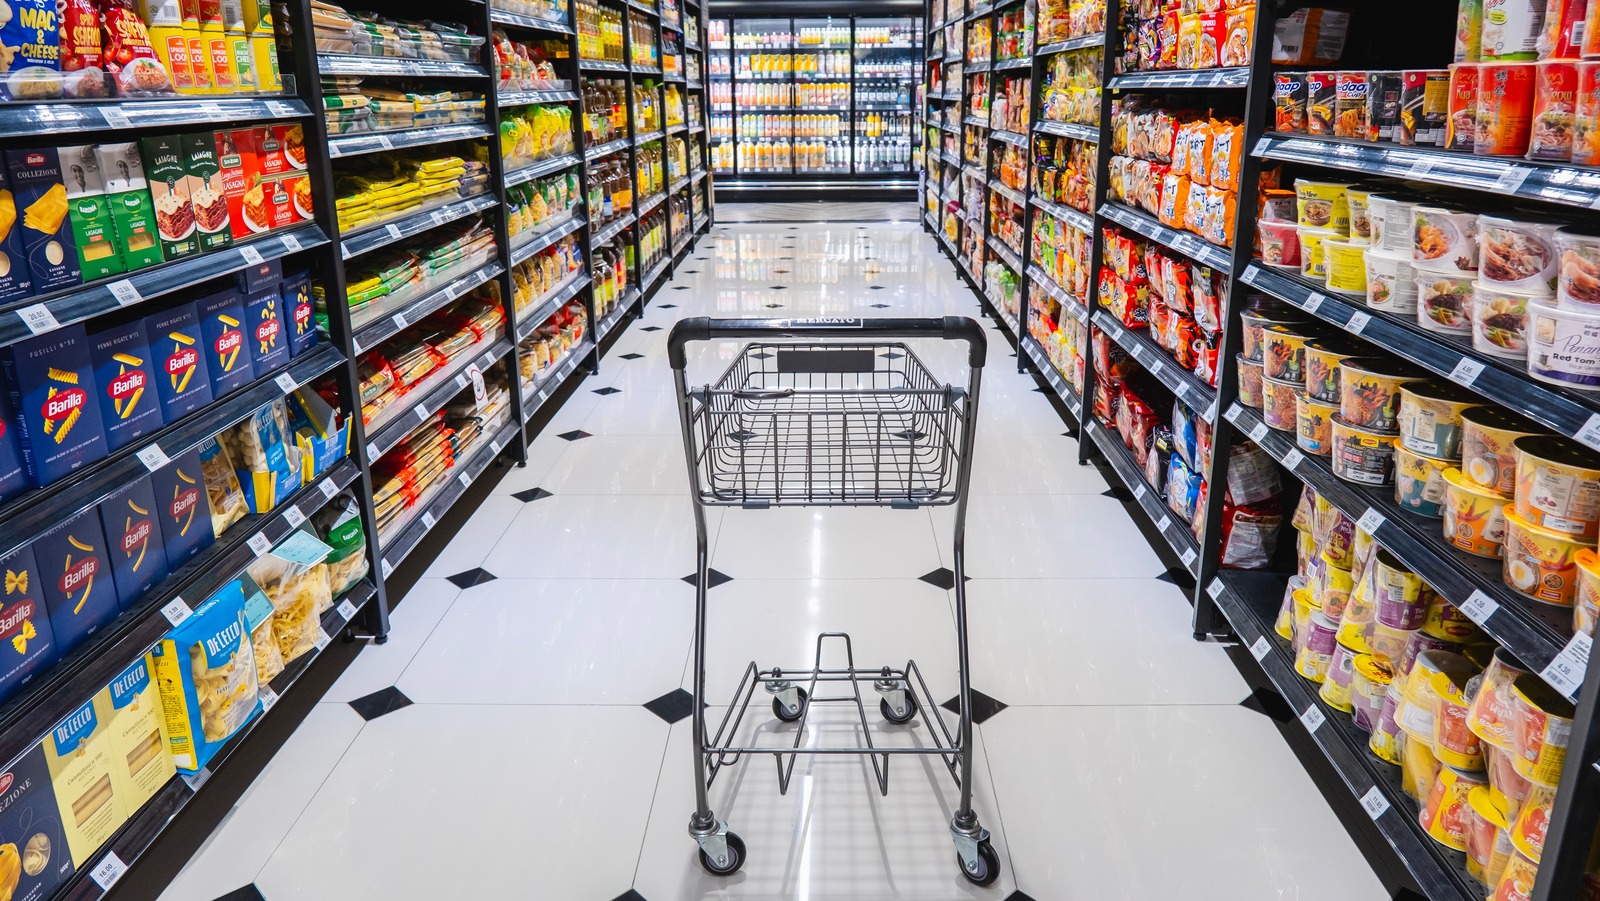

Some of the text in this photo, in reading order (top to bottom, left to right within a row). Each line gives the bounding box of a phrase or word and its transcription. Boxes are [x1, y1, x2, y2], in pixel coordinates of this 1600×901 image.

[20, 7, 56, 32] MAC
[37, 29, 45, 45] &
[20, 43, 59, 60] CHEESE
[27, 155, 45, 164] Barilla
[264, 160, 283, 168] LASAGNA
[17, 168, 58, 179] COLLEZIONE
[223, 180, 246, 191] LASAGNA
[28, 311, 45, 322] 20.05
[296, 306, 311, 322] Barilla
[156, 321, 169, 329] PENNE
[169, 316, 182, 326] RIGATE
[259, 322, 279, 339] Barilla
[97, 341, 112, 350] PENNE
[112, 335, 129, 347] RIGATE
[218, 333, 241, 352] Barilla
[29, 345, 57, 359] FUSILLI
[1553, 353, 1595, 365] Red Tom
[169, 352, 196, 372] Barilla
[1462, 365, 1473, 374] 4.95
[113, 374, 144, 395] Barilla
[48, 394, 83, 417] Barilla
[173, 492, 197, 514] Barilla
[125, 524, 150, 549] Barilla
[64, 561, 95, 589] Barilla
[1473, 597, 1486, 608] 4.30
[0, 604, 31, 634] Barilla
[168, 606, 179, 616] 5.99
[206, 621, 240, 657] DE CECCO
[1557, 662, 1571, 675] 4.30
[113, 664, 145, 699] DE CECCO
[57, 706, 93, 744] DE CECCO
[1370, 795, 1384, 809] 11.65
[98, 863, 113, 879] 16.00
